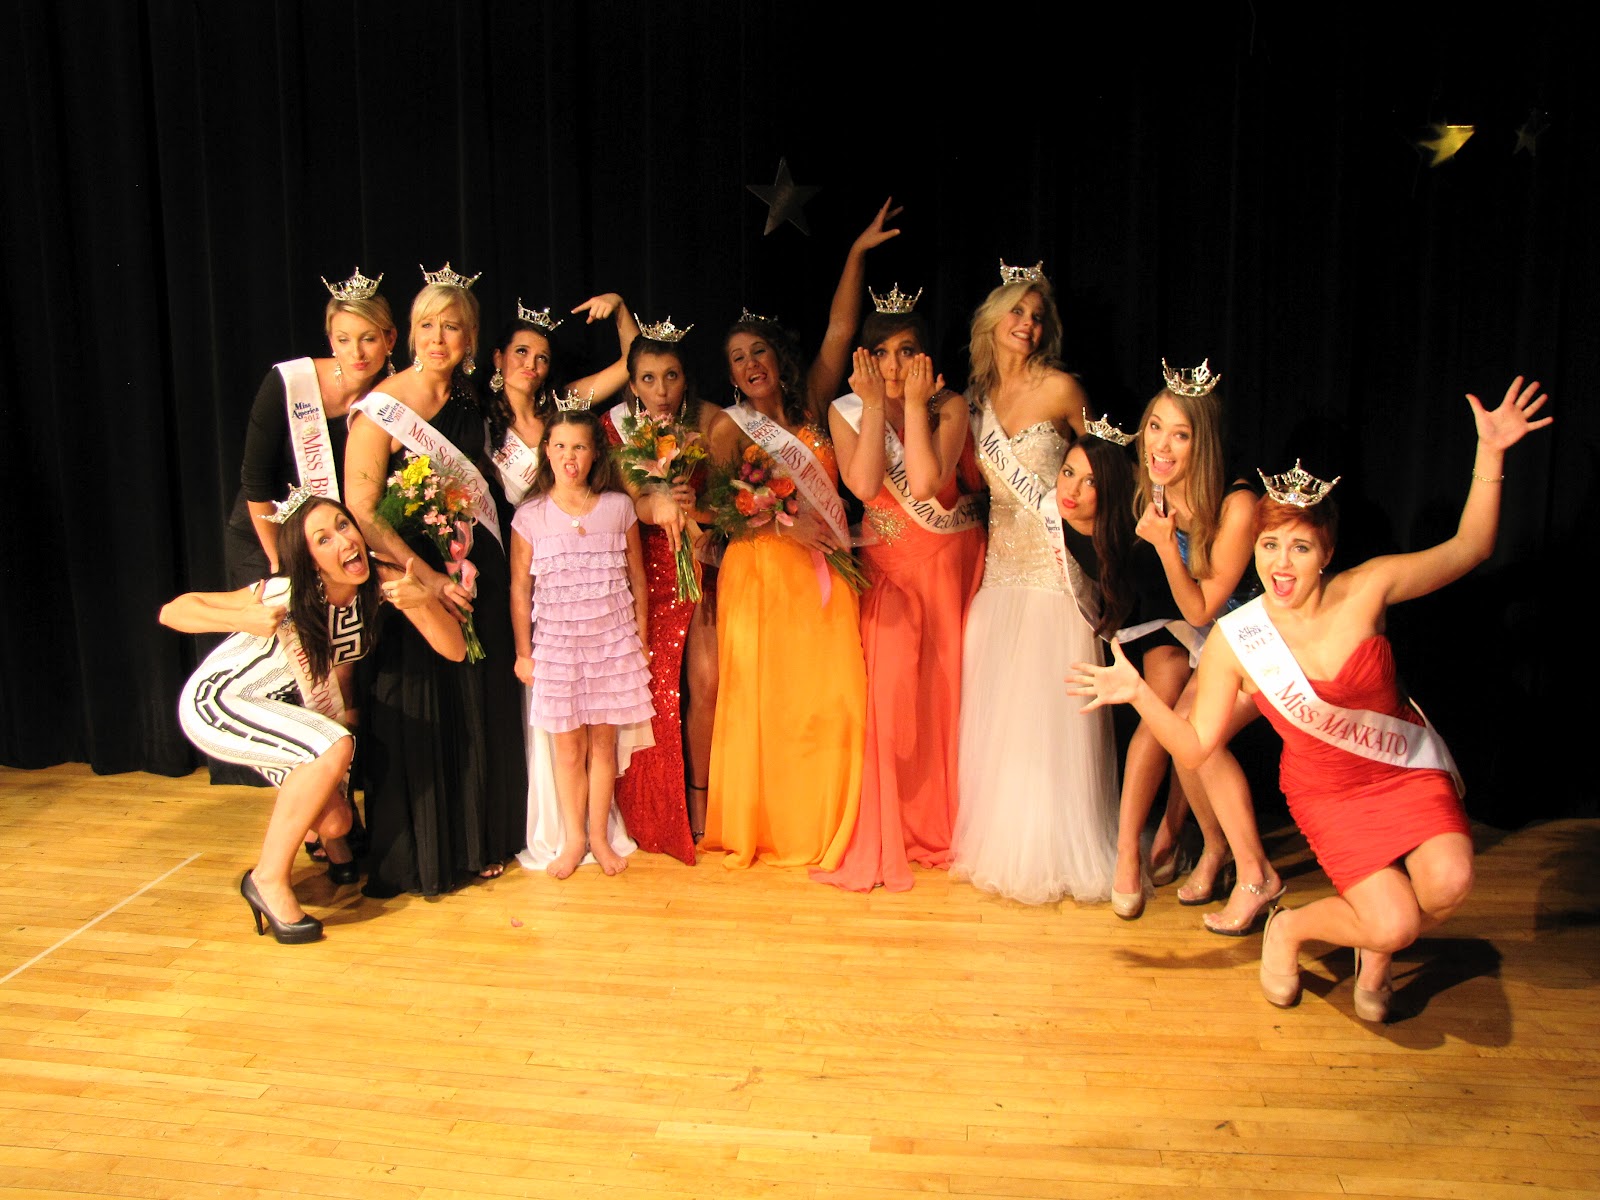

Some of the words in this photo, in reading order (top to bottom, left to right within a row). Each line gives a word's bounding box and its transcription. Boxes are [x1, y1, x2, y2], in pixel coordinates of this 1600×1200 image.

[292, 407, 319, 420] America
[294, 402, 311, 410] Miss
[377, 404, 390, 416] Miss
[382, 402, 400, 425] America
[394, 406, 406, 421] 2012
[304, 413, 320, 422] 2012
[408, 422, 436, 451] MISS
[504, 449, 524, 469] 2012
[779, 440, 806, 470] MISS
[980, 430, 1009, 471] MISS
[1317, 714, 1408, 756] MANKATO
